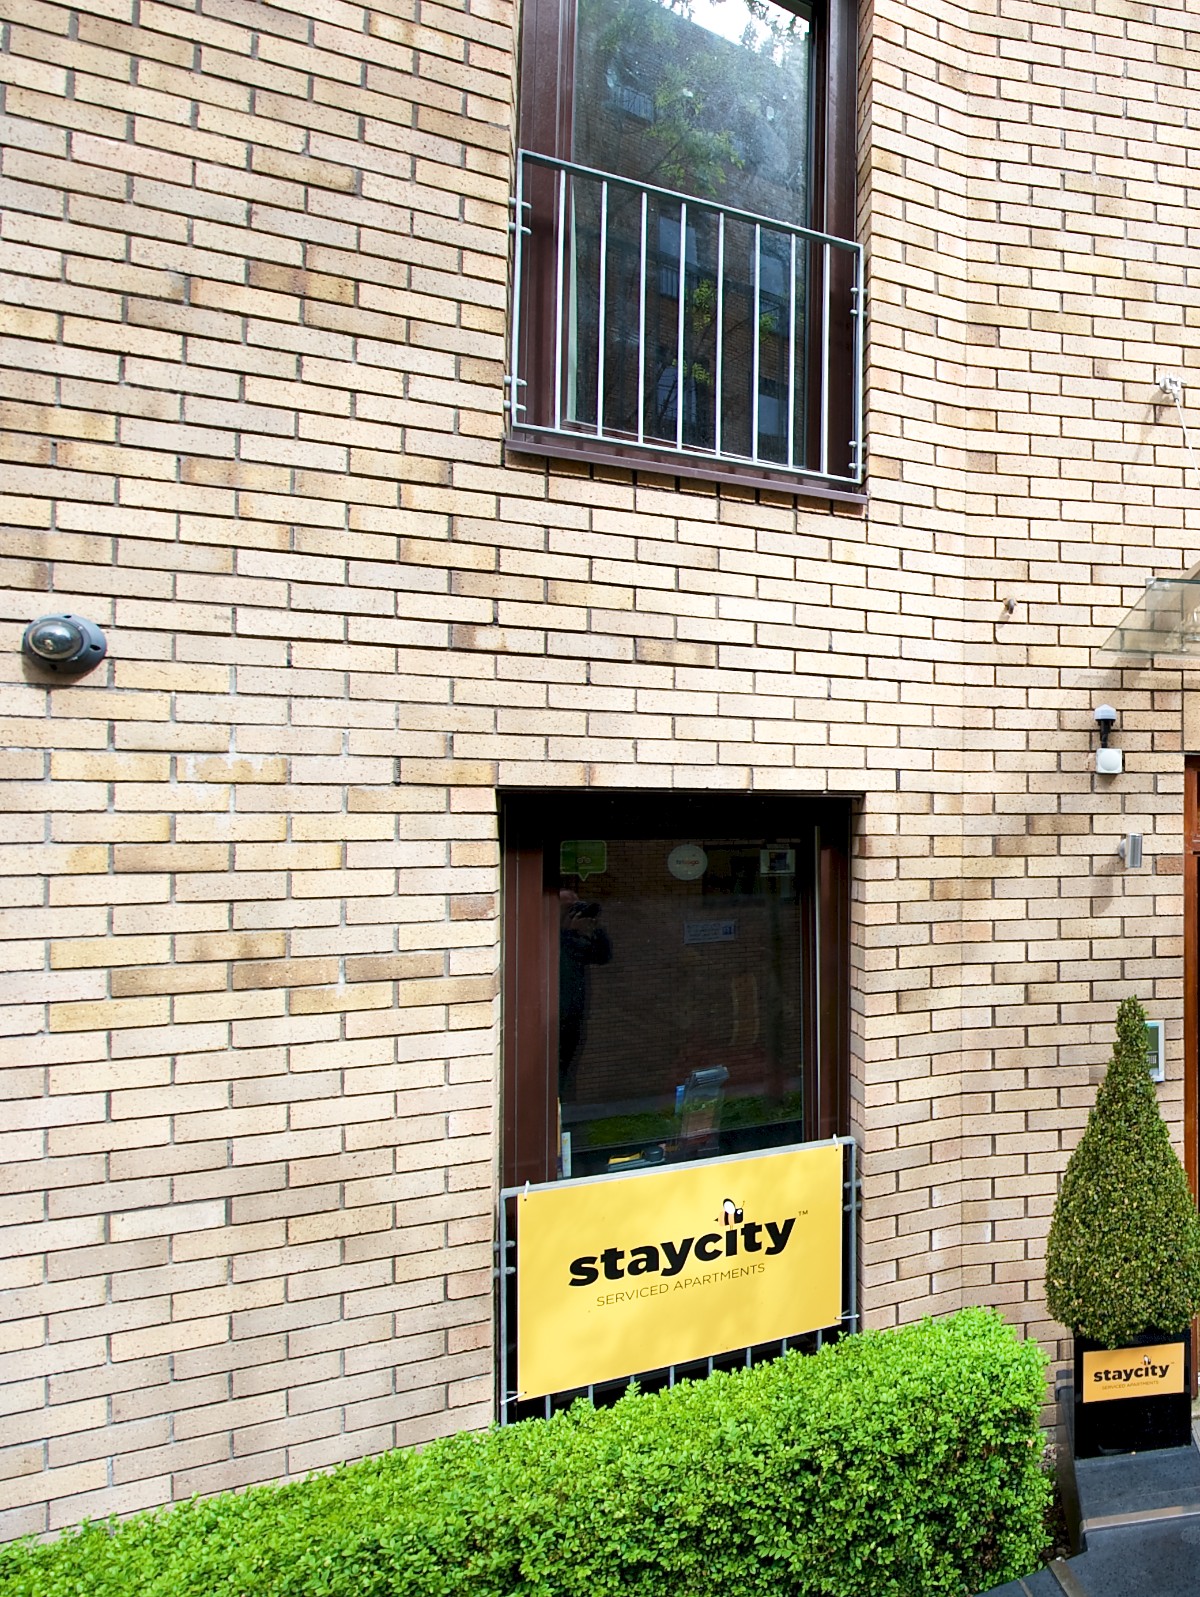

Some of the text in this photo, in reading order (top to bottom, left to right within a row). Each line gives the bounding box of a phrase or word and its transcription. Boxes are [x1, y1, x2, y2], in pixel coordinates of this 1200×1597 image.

[569, 1218, 796, 1287] staycity
[596, 1263, 765, 1307] SERVICED APARTMENTS
[1093, 1365, 1169, 1382] staycity
